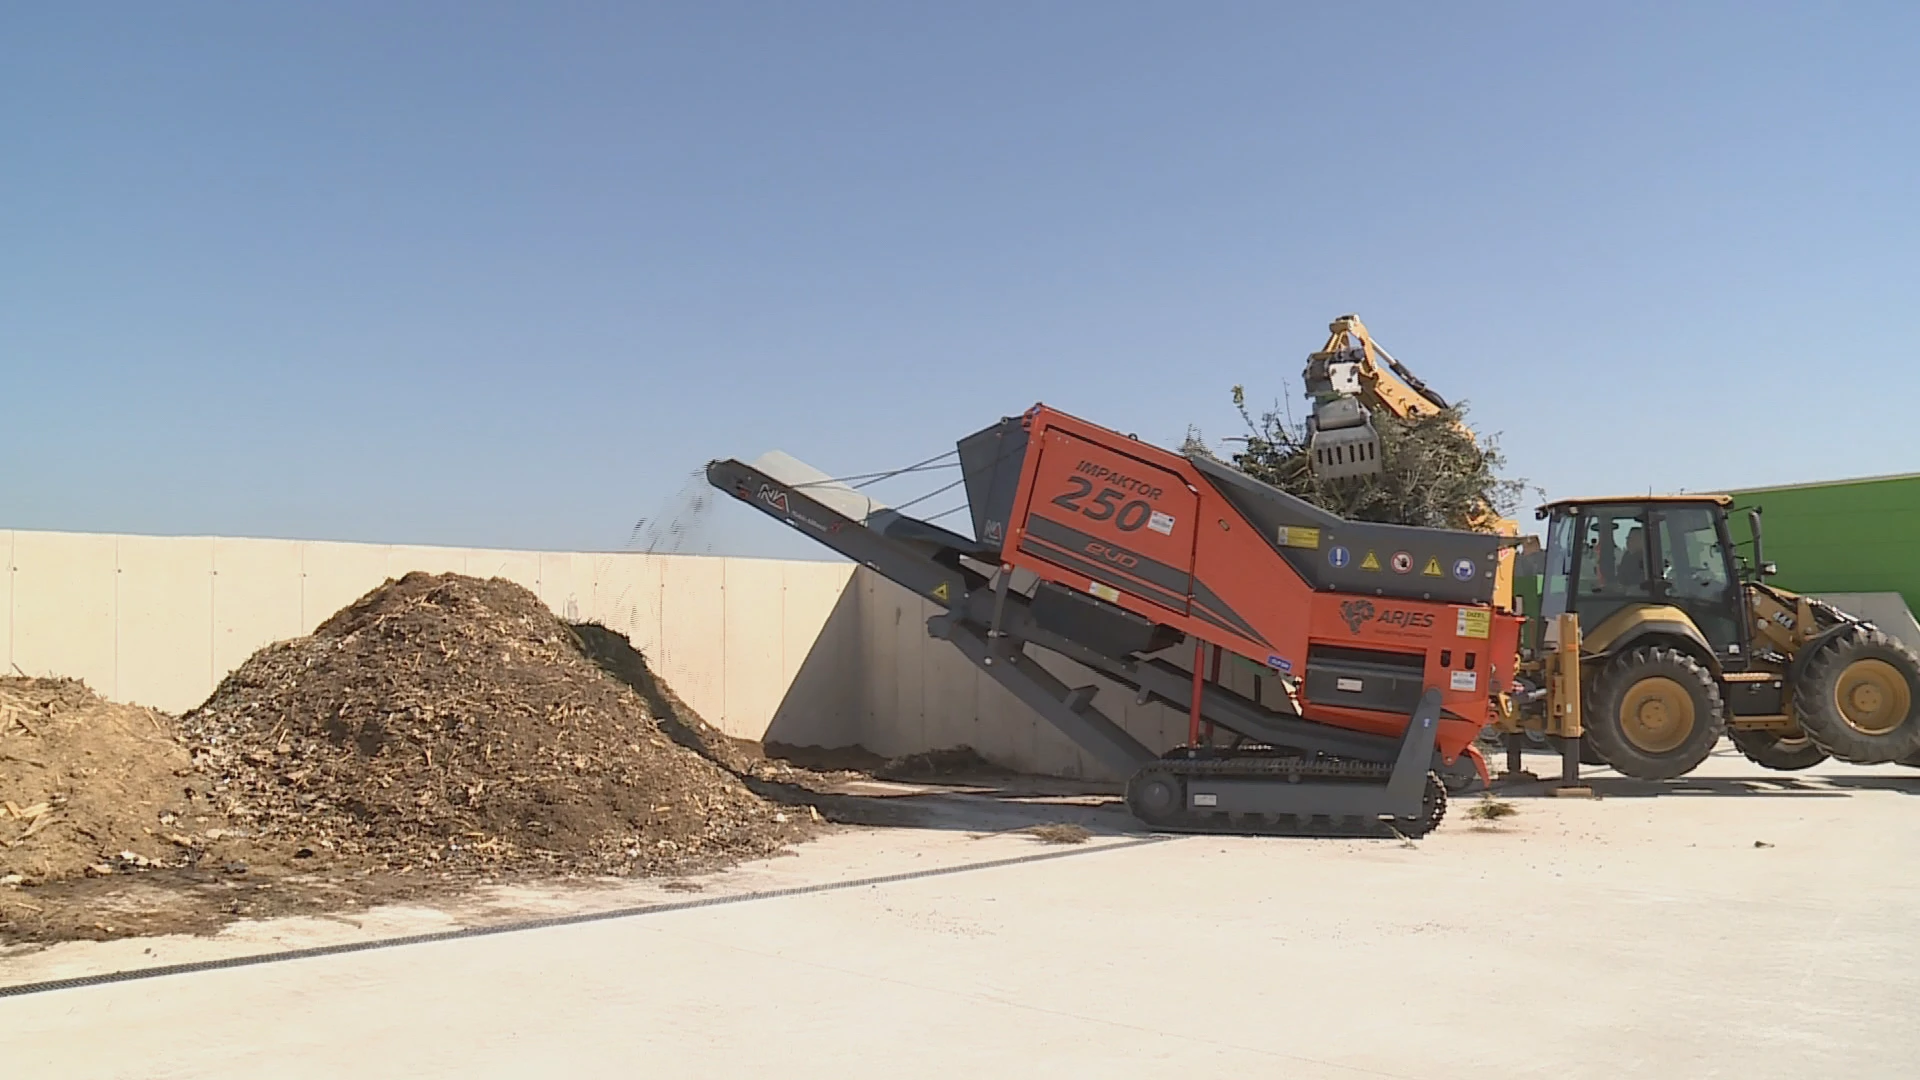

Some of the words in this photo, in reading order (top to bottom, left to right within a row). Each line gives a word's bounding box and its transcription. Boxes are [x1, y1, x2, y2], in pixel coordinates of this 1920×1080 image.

[1076, 460, 1163, 500] IMPAKTOR
[1052, 476, 1150, 531] 250
[1377, 610, 1436, 628] ARJES
